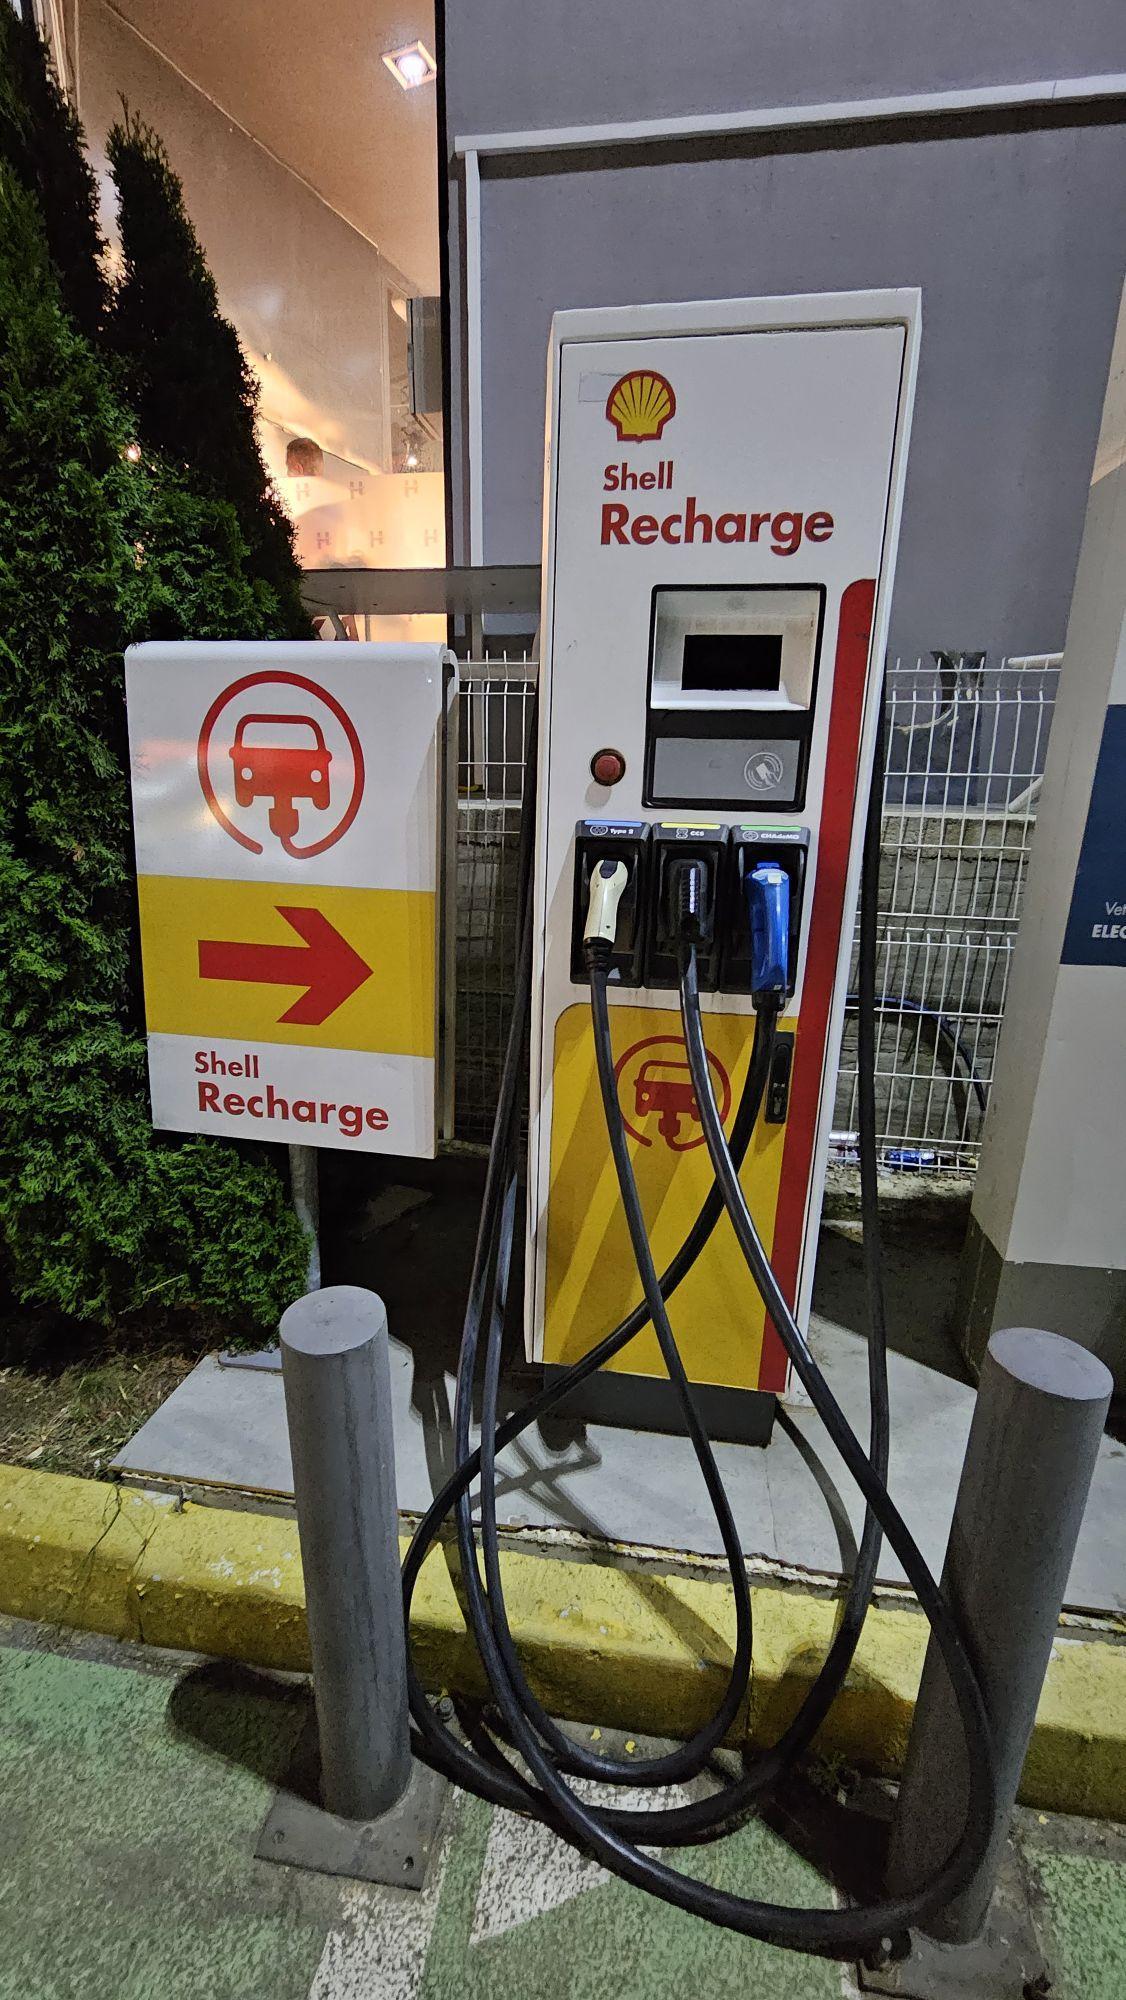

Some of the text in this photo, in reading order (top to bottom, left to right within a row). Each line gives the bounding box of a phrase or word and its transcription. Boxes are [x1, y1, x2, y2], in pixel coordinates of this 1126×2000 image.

[603, 460, 674, 491] Shell
[600, 497, 835, 556] Recharge
[194, 1050, 260, 1078] Shell
[197, 1081, 389, 1137] Recharge
